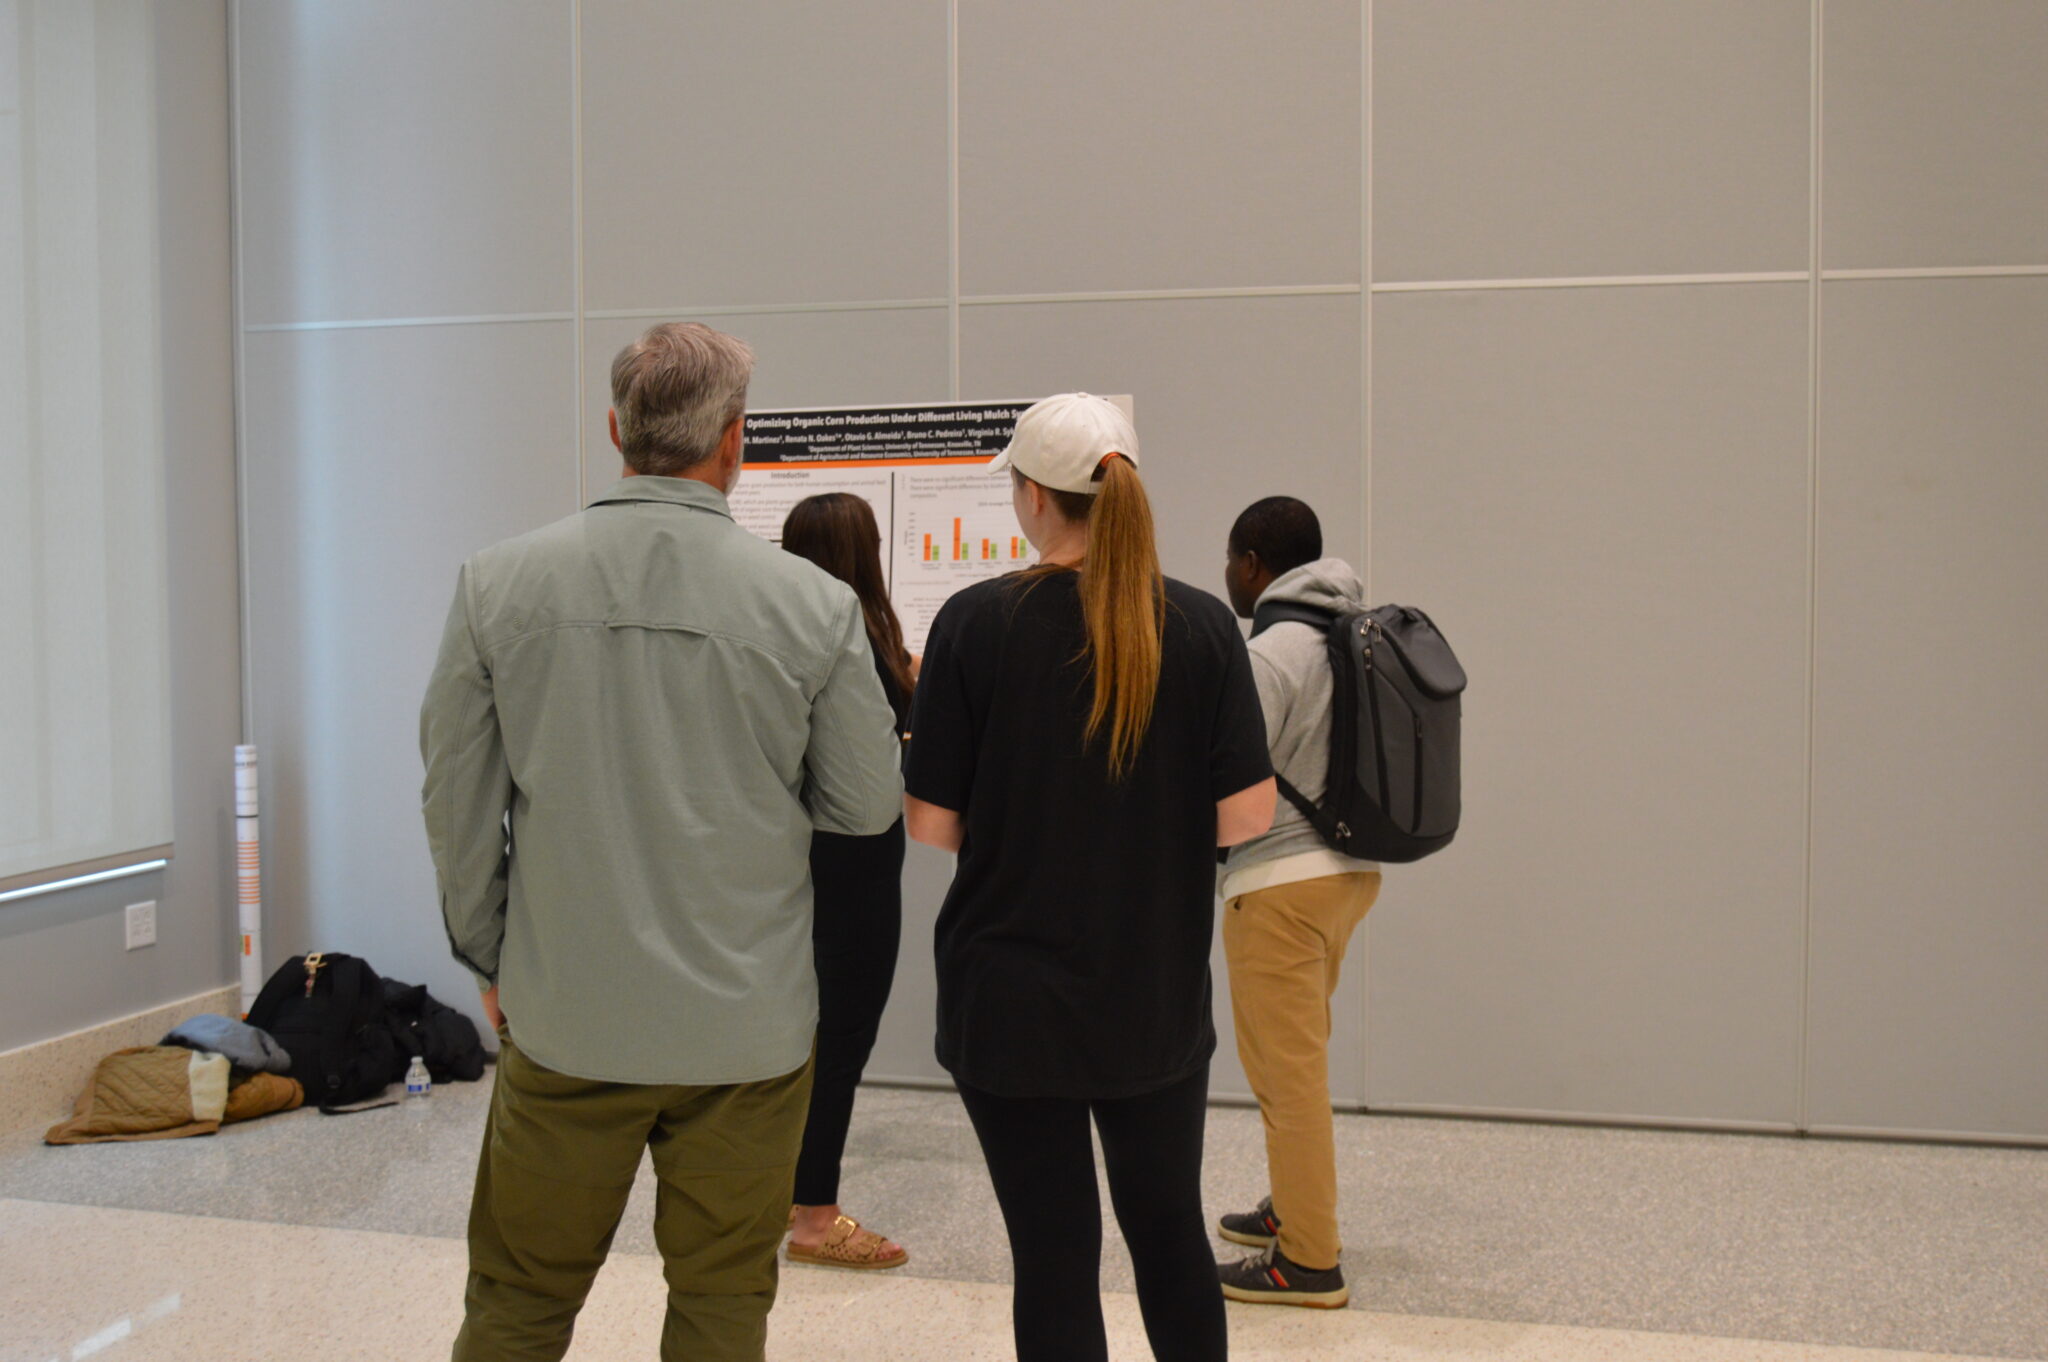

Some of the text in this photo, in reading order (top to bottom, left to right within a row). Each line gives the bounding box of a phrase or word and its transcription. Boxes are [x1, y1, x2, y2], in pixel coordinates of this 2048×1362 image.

[746, 418, 792, 430] Optimizing
[792, 417, 824, 428] Organic
[825, 416, 845, 425] Corn
[846, 414, 890, 425] Production
[891, 413, 917, 423] Under
[918, 411, 955, 422] Different
[956, 411, 983, 422] Living
[984, 409, 1010, 420] Mulch
[785, 434, 808, 443] Renata
[906, 430, 927, 439] Bruno
[968, 428, 994, 439] Virginia
[771, 471, 810, 479] Introduction
